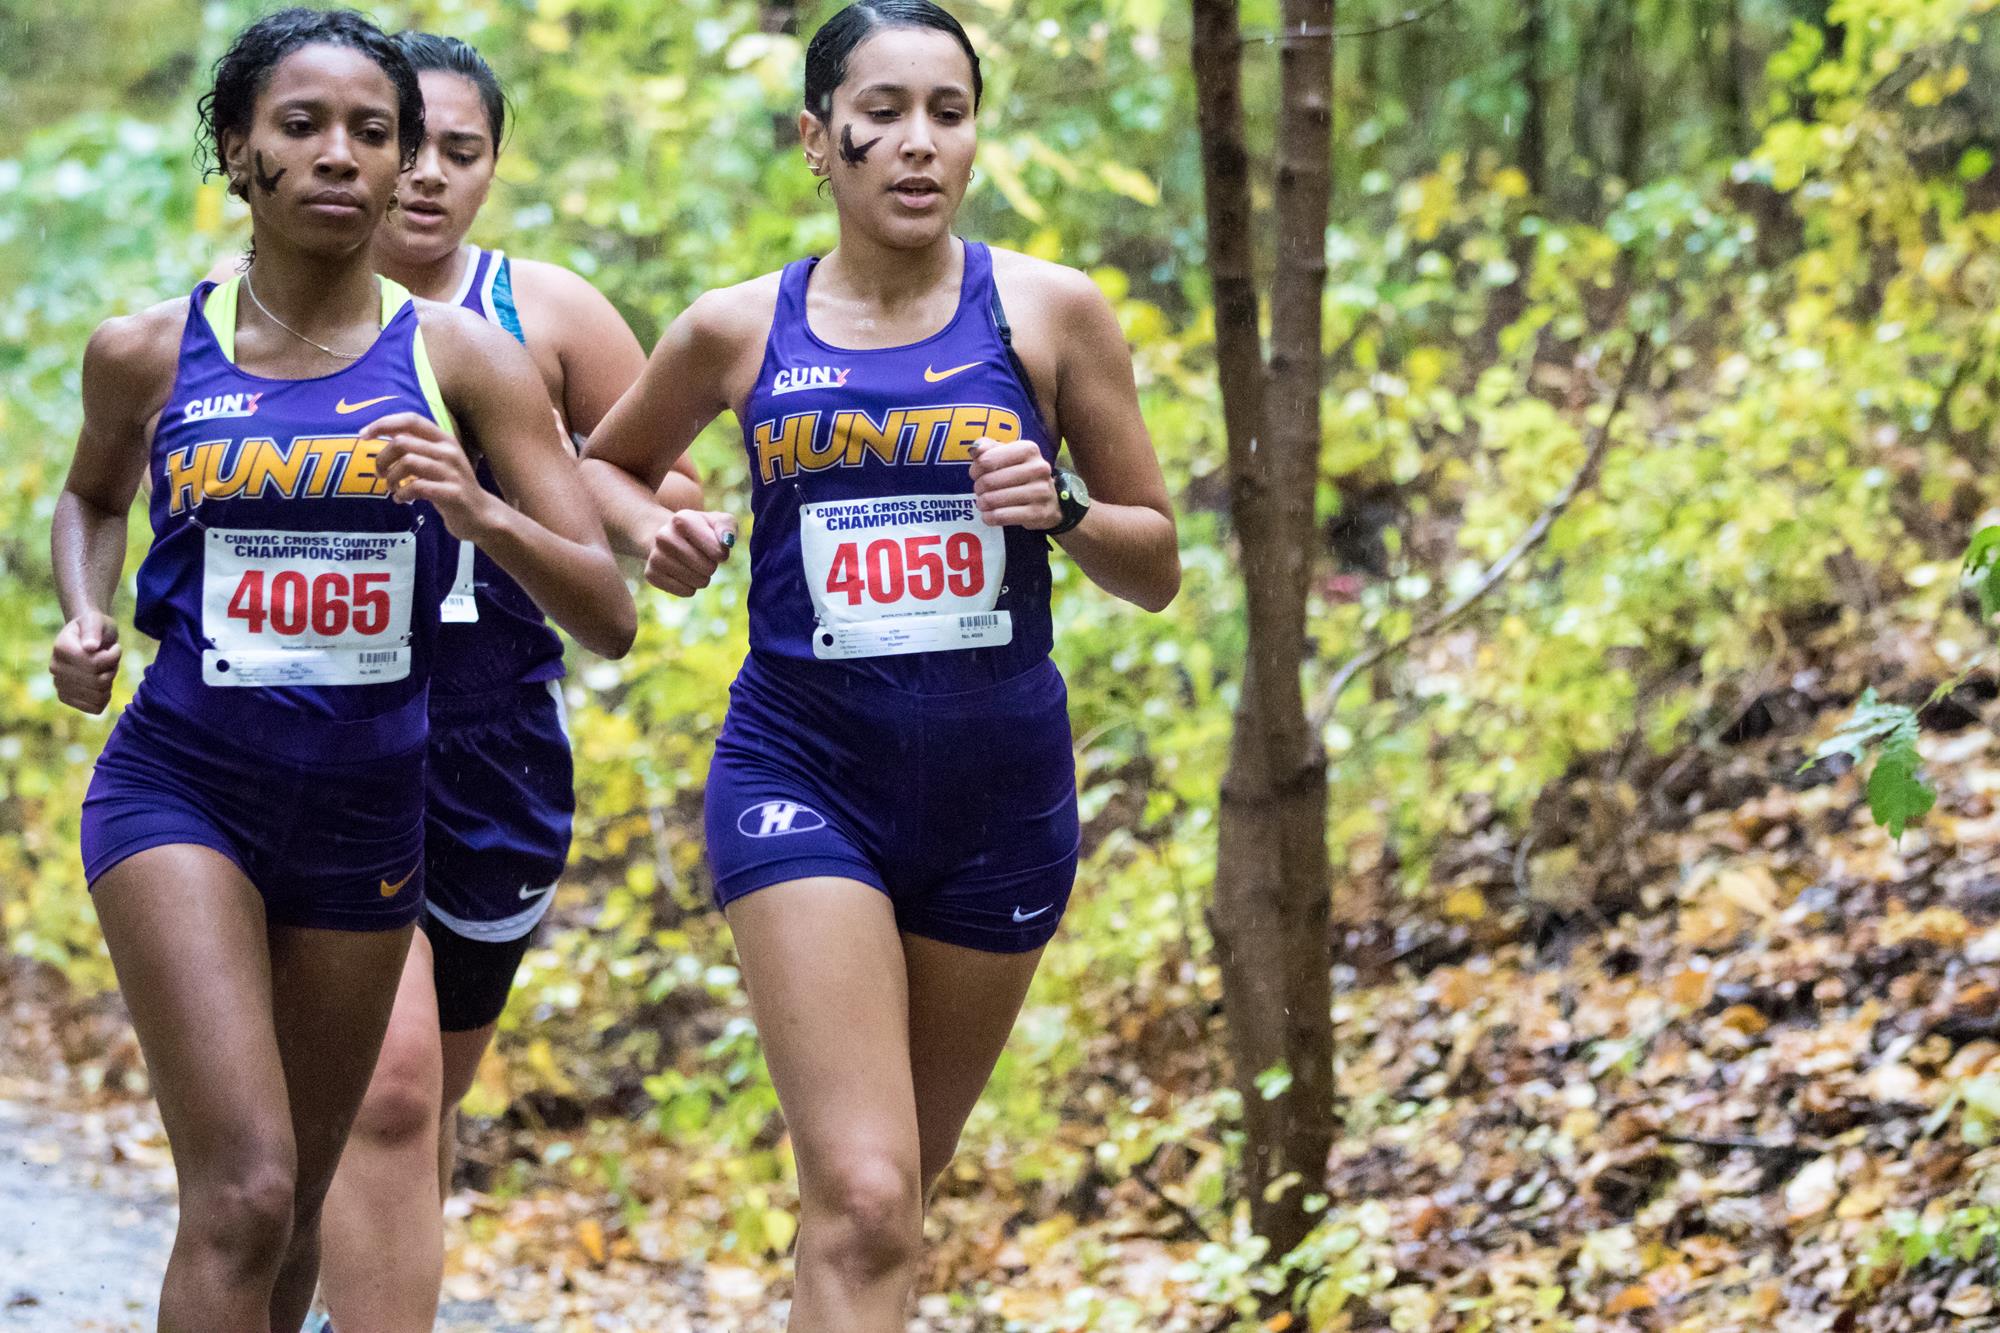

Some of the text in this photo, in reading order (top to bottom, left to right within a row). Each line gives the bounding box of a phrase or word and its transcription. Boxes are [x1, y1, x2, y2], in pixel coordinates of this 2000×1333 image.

[774, 366, 851, 391] CUNY
[183, 392, 264, 420] CUNY
[164, 434, 400, 517] HUNTE
[816, 505, 869, 518] CUNYAC
[873, 501, 918, 514] CROSS
[826, 509, 975, 531] CHAMPIONSHIPS
[224, 534, 398, 549] CUNYAC CROSS COUNTRY
[234, 545, 388, 561] CHAMPIONSHIPS
[826, 532, 985, 606] 4059
[227, 570, 391, 636] 4065
